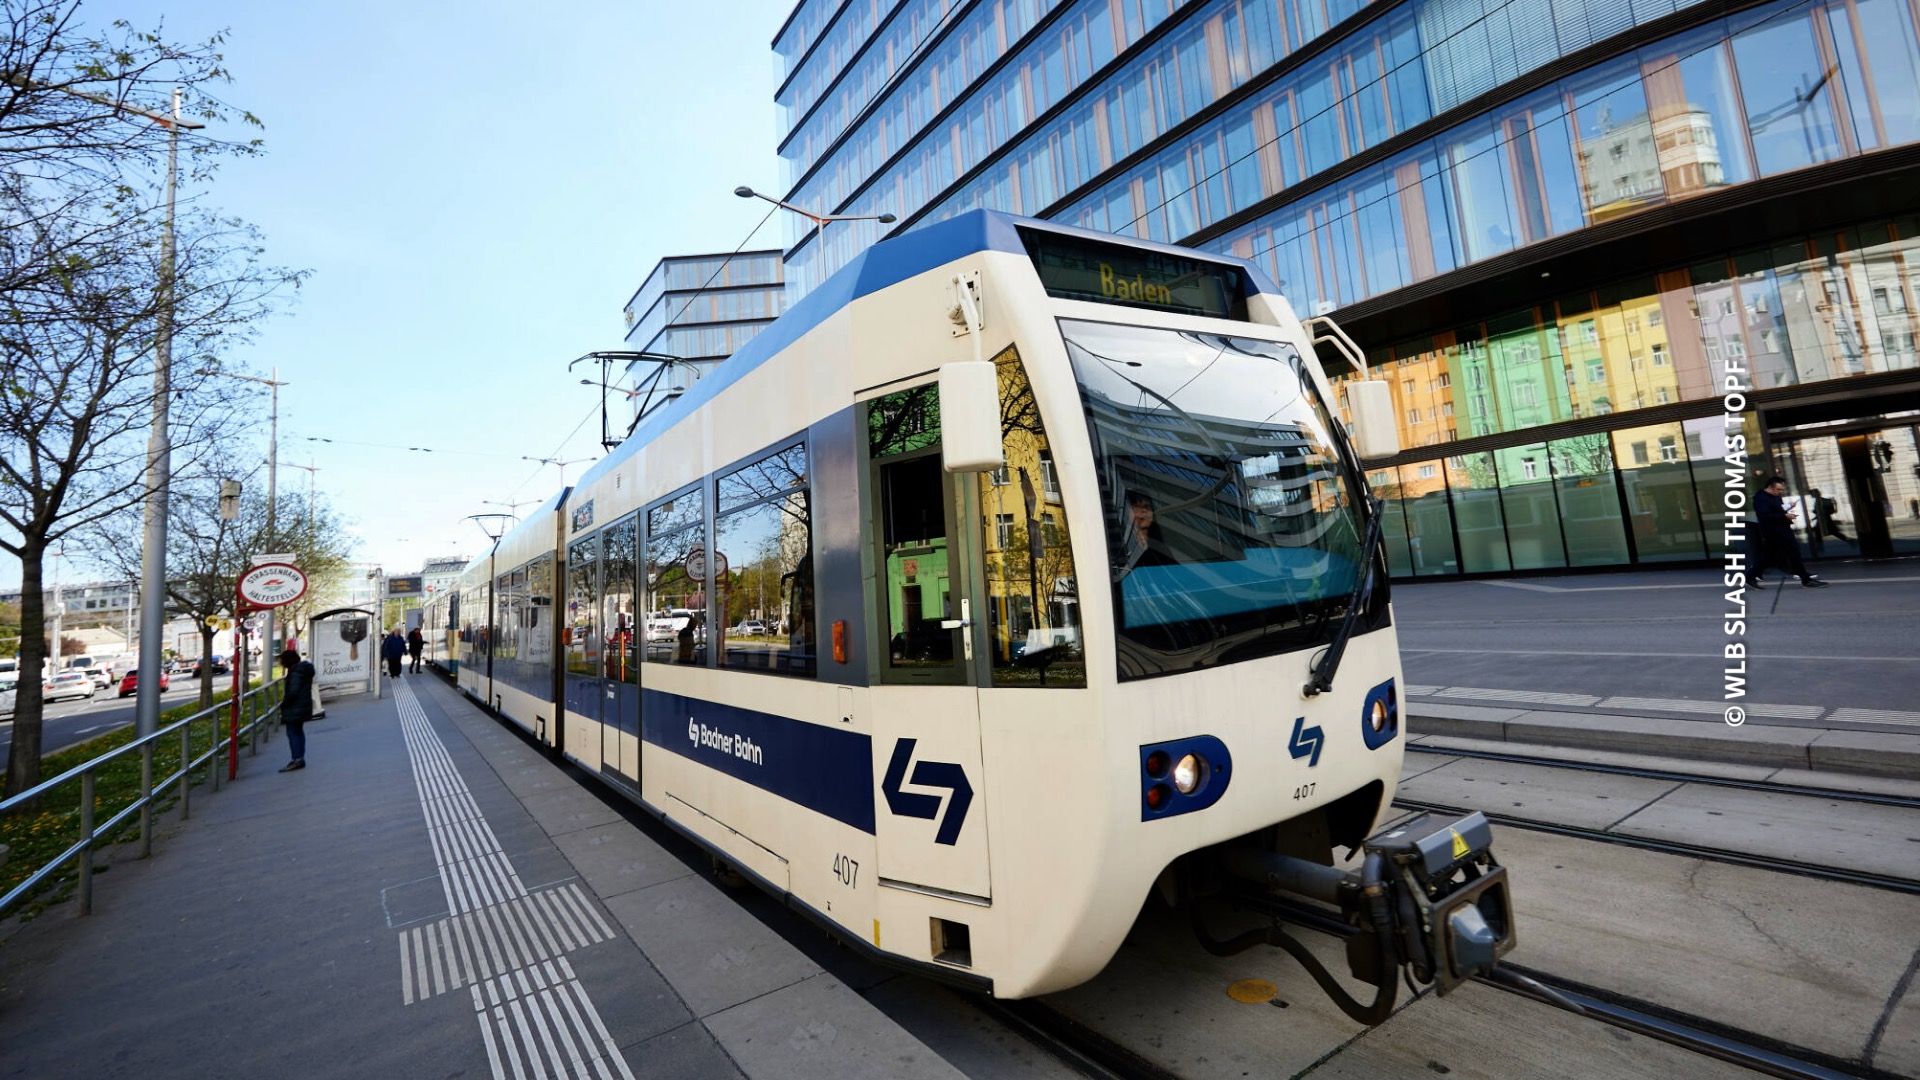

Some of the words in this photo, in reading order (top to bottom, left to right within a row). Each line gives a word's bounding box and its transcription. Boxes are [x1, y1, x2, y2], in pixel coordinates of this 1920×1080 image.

[1100, 263, 1171, 305] Baden
[247, 568, 301, 584] STRASSENBAHN
[248, 588, 298, 602] HALTESTELLE
[323, 658, 339, 668] Der
[700, 723, 734, 755] Badner
[734, 733, 763, 766] Bahn
[1293, 782, 1317, 801] 407
[833, 852, 859, 890] 407
